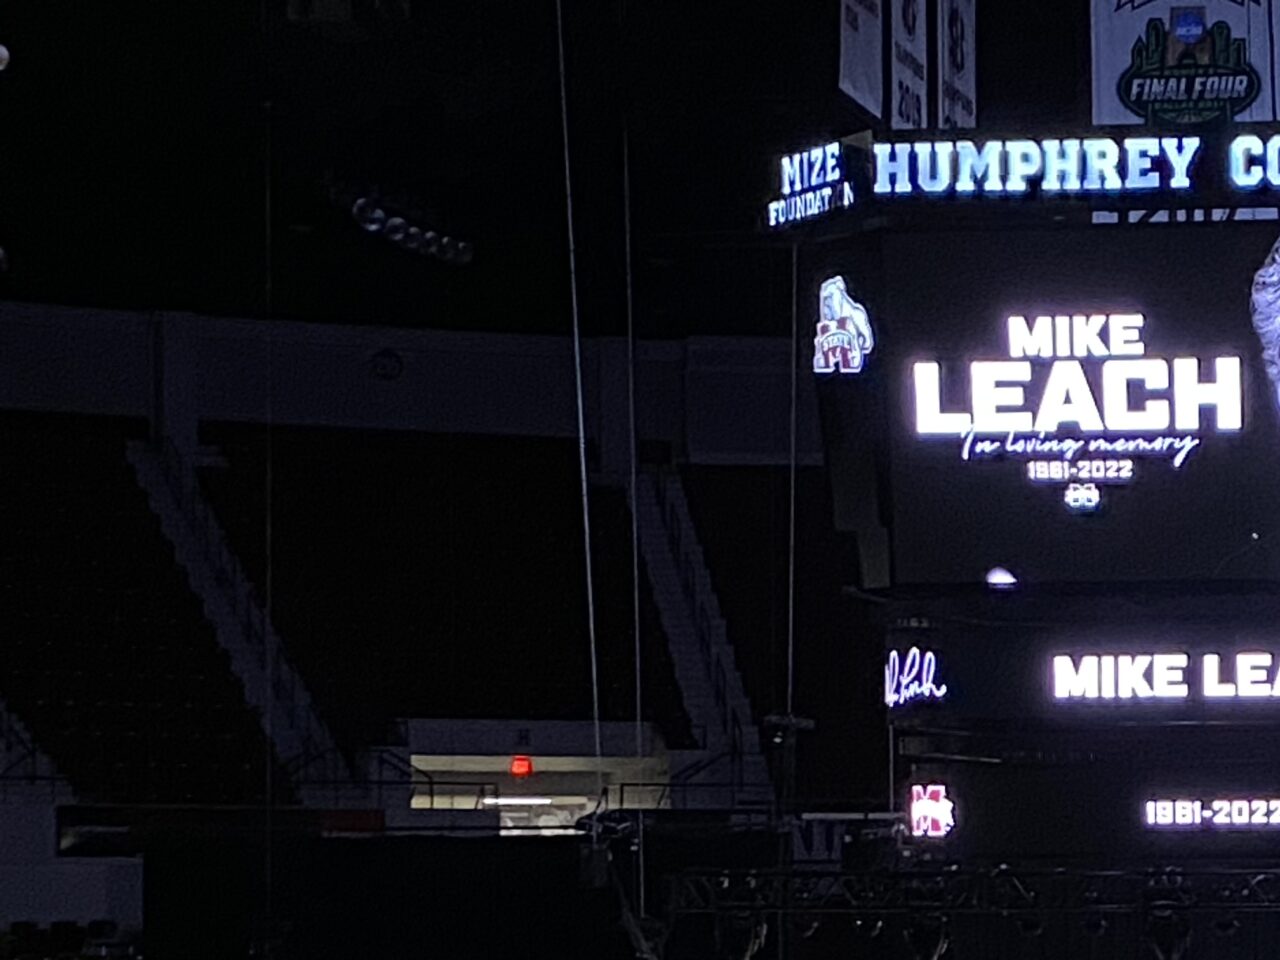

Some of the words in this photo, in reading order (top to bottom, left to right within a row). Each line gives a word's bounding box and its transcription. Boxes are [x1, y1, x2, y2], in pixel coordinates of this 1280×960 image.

[1129, 77, 1188, 101] FINAL
[1191, 75, 1249, 100] FOUR
[781, 141, 840, 195] MIZE
[873, 139, 1200, 193] HUMPHREY
[1008, 314, 1145, 357] MIKE
[913, 357, 1242, 433] LEACH
[1005, 428, 1084, 459] loving
[1088, 436, 1199, 467] memory
[1053, 653, 1189, 698] MIKE
